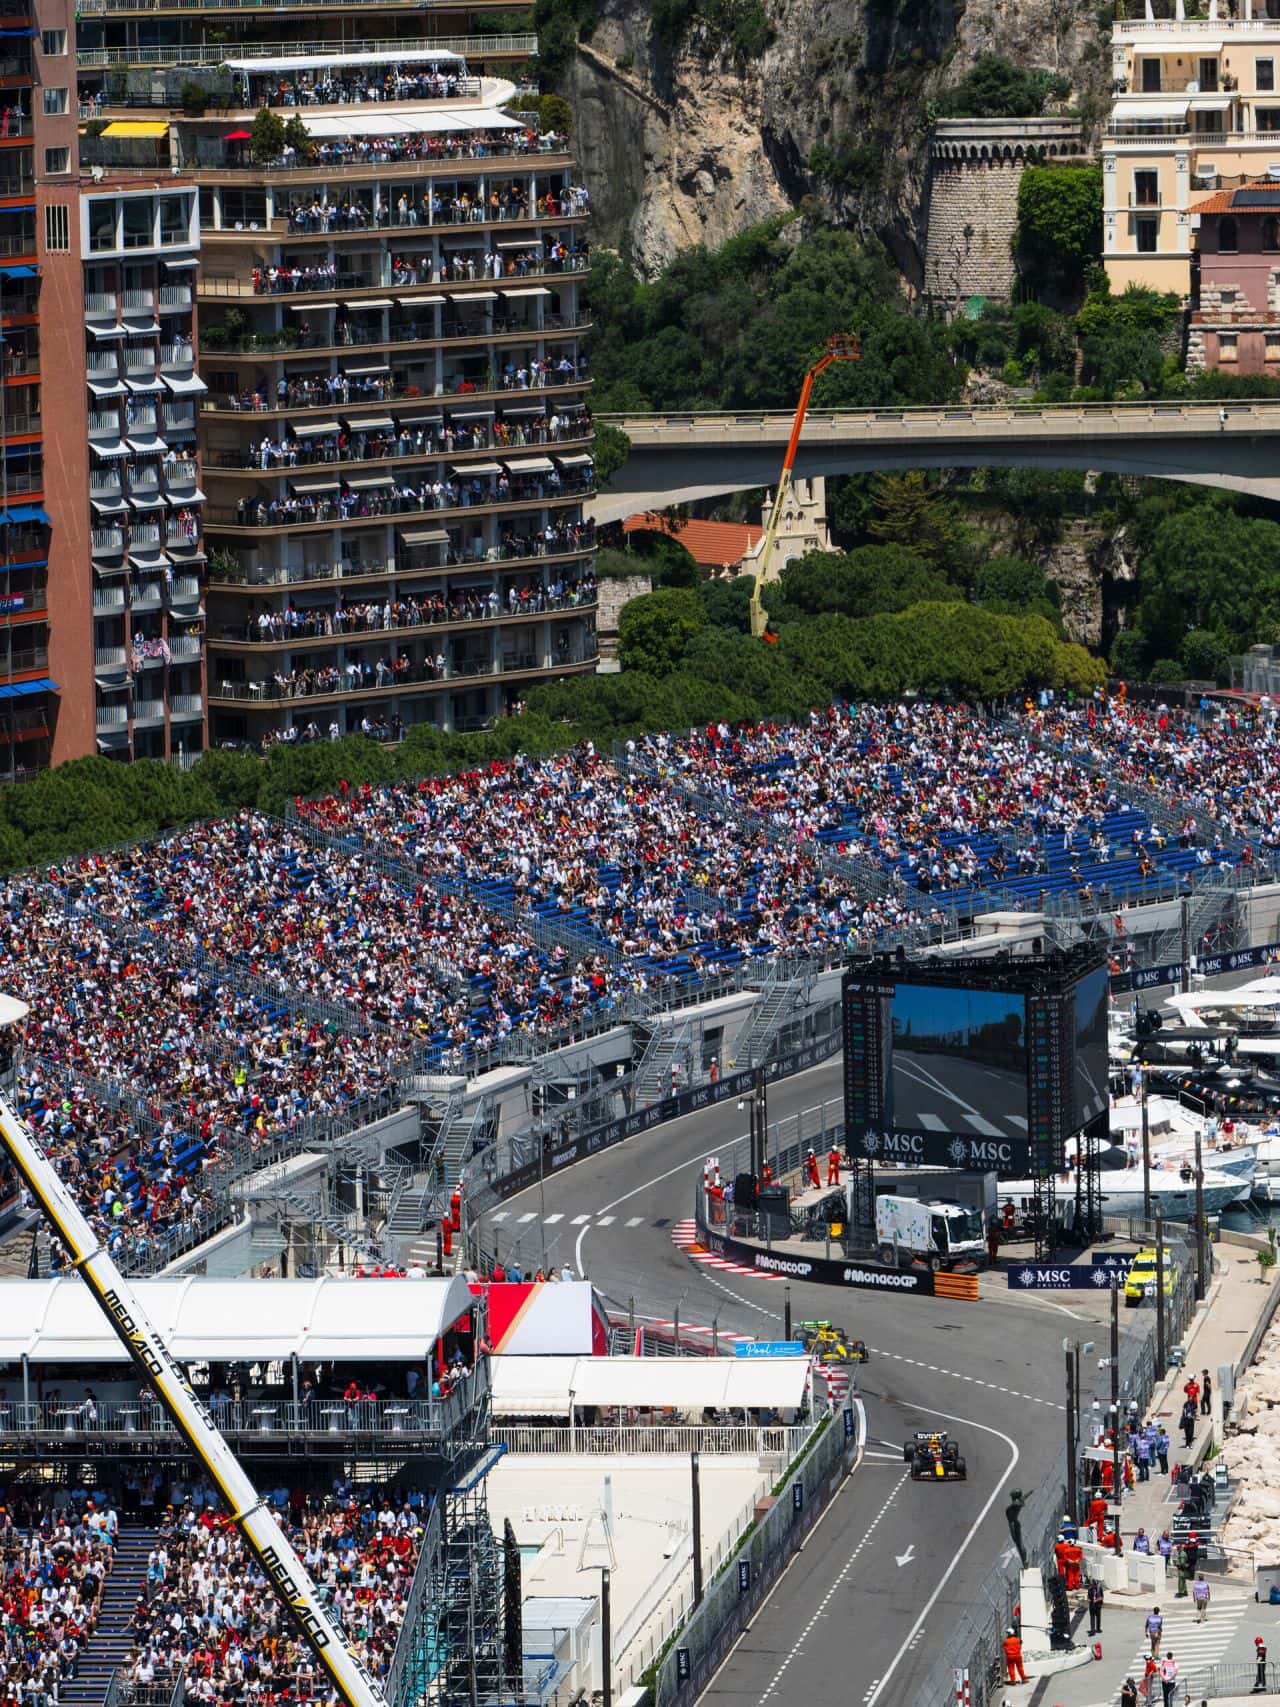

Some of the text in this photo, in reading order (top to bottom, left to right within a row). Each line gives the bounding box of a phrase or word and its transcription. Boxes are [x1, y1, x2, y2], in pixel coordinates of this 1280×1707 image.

[1206, 958, 1222, 971] MSC
[1143, 971, 1160, 983] MSC
[883, 1132, 924, 1153] MSC
[970, 1141, 1012, 1161] MSC
[755, 1253, 812, 1275] #MonacoGP
[844, 1268, 918, 1287] #MonacoGP
[1036, 1270, 1071, 1282] MSC
[1109, 1270, 1129, 1282] MS
